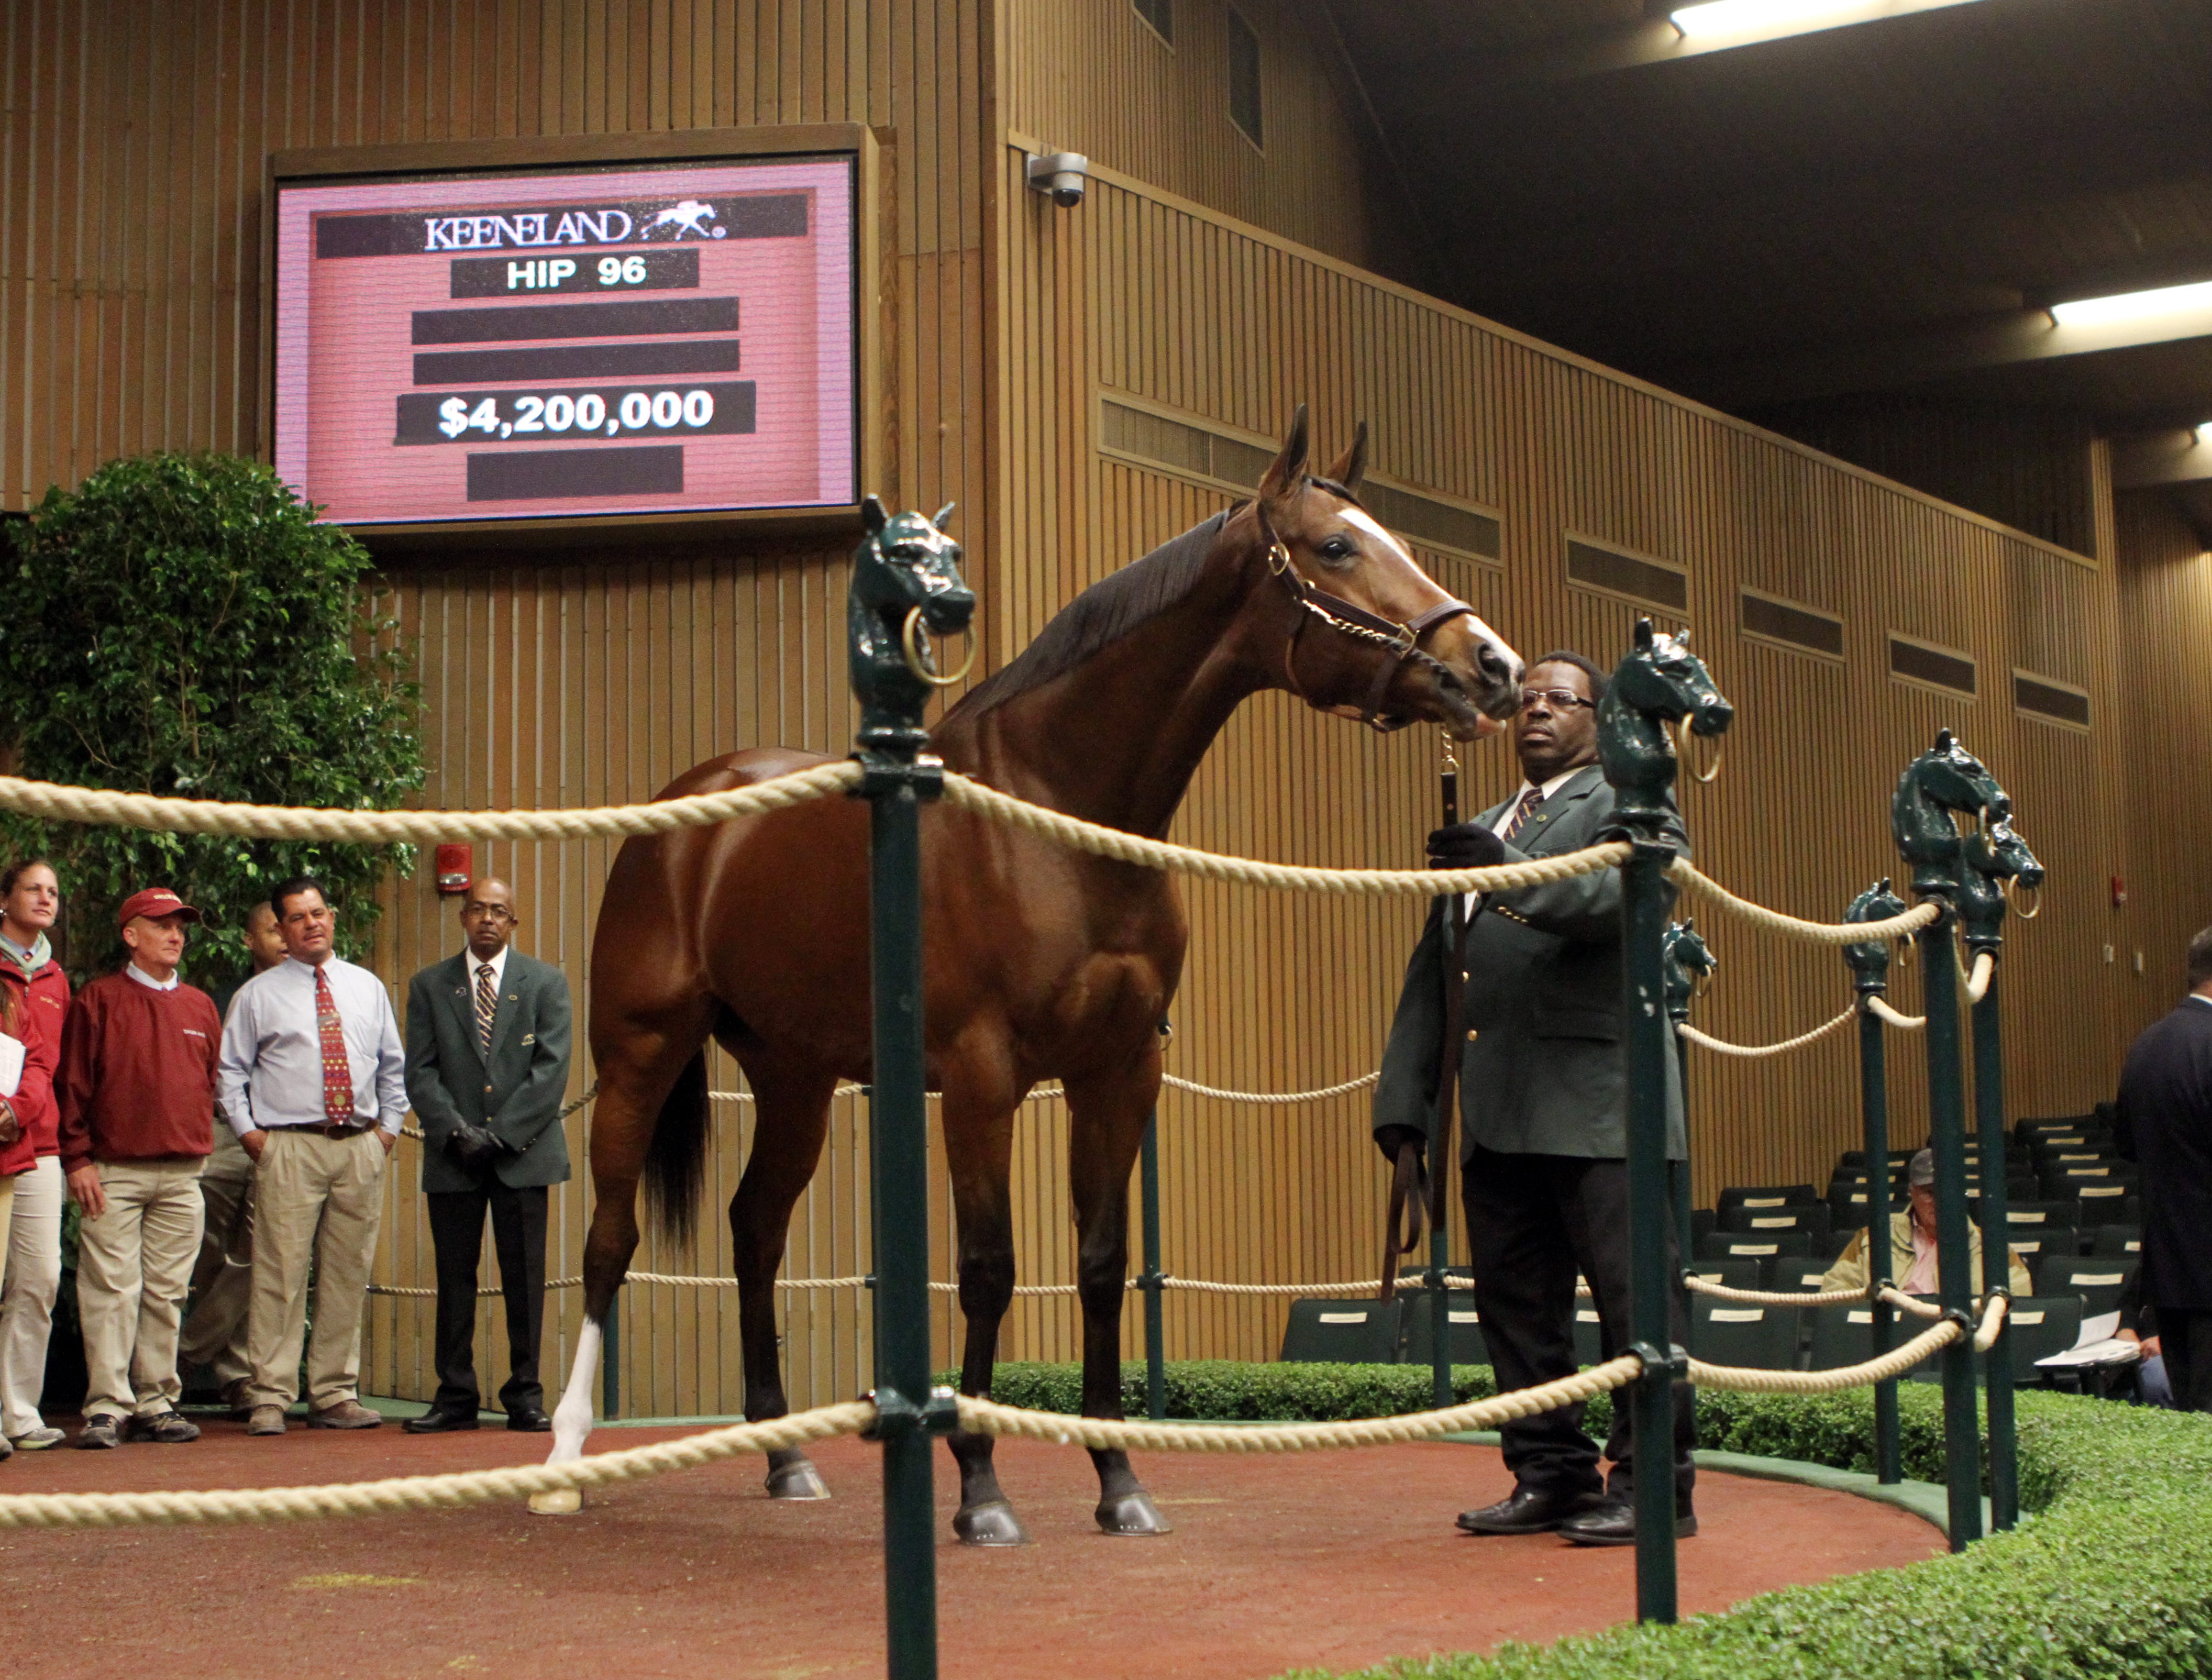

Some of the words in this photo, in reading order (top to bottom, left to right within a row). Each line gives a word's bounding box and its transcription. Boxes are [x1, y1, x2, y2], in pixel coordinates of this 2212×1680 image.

[425, 210, 632, 251] KEENELAND
[507, 259, 576, 289] HIP
[598, 256, 646, 285] 96
[439, 390, 714, 439] $4,200,000
